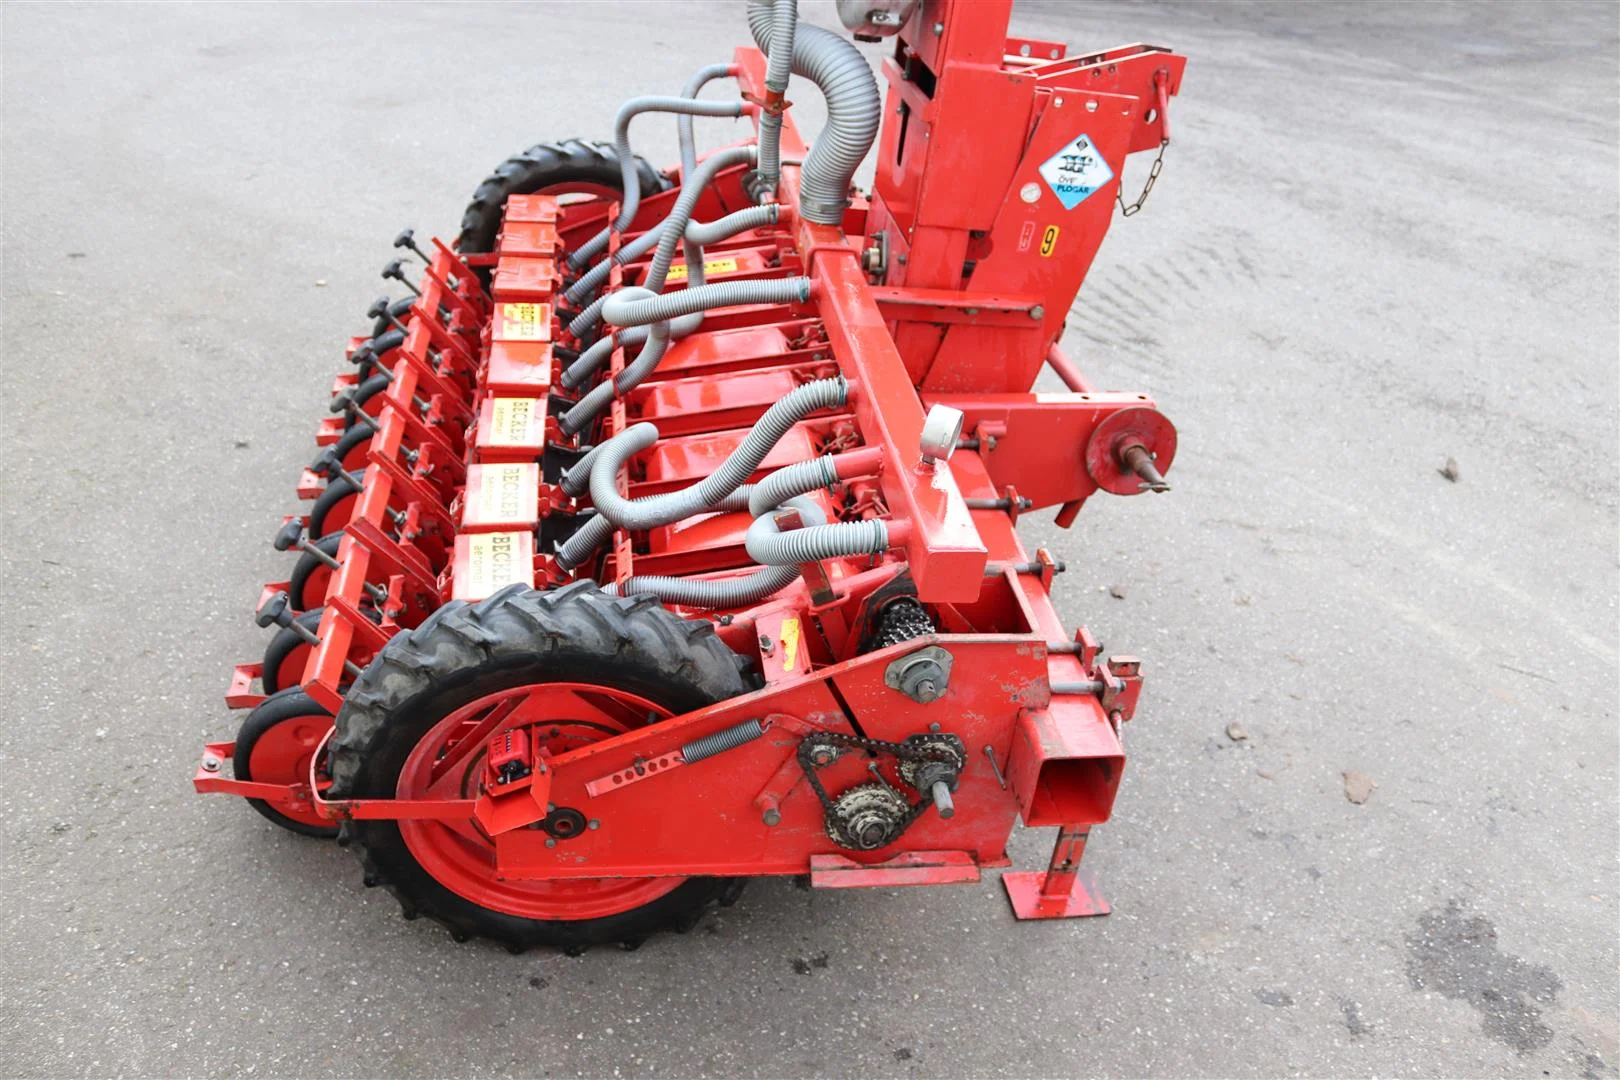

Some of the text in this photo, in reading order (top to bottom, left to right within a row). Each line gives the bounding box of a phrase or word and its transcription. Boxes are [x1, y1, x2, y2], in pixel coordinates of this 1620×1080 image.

[1041, 227, 1056, 255] 9
[510, 401, 529, 441] BECKER
[500, 467, 520, 518] BECKER
